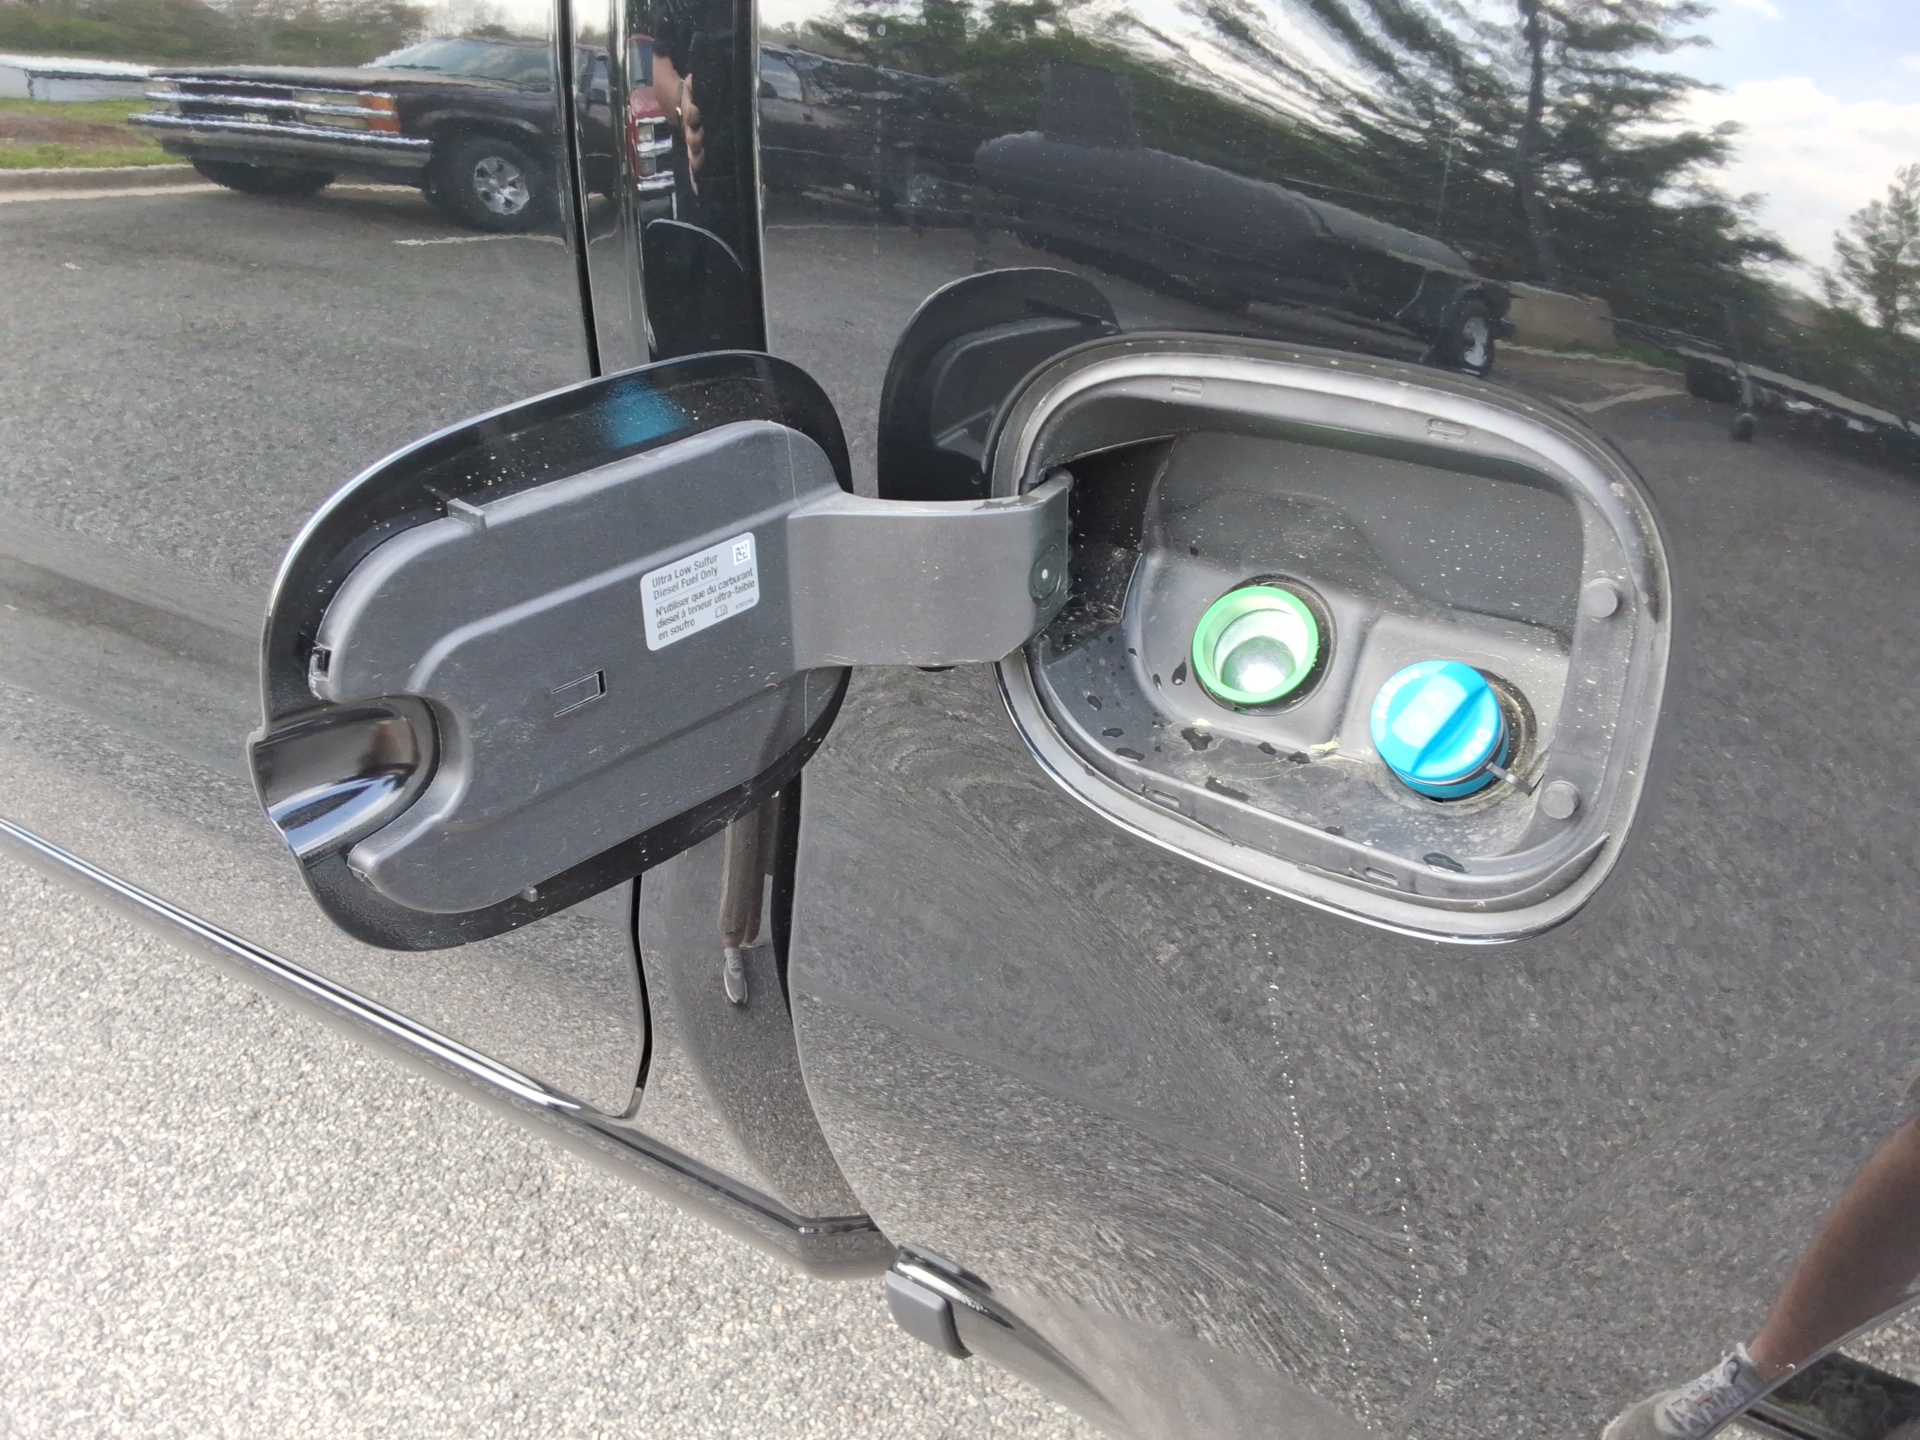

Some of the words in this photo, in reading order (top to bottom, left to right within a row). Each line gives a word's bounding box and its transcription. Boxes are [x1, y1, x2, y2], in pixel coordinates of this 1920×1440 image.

[652, 573, 672, 587] Ultra
[675, 566, 692, 578] Low
[694, 554, 718, 570] Sulfur
[654, 583, 679, 600] Diesel
[682, 575, 698, 589] Fuel
[701, 567, 718, 580] Only
[656, 595, 689, 617] N'utiliser
[692, 590, 705, 604] que
[707, 584, 716, 595] du
[718, 568, 753, 590] carburant
[657, 612, 679, 628] diesel
[682, 606, 686, 618] à
[688, 598, 712, 615] teneur
[715, 580, 755, 604] ultra-faible
[658, 630, 668, 640] en
[670, 618, 695, 635] soufre
[1373, 668, 1421, 720] AdBlue
